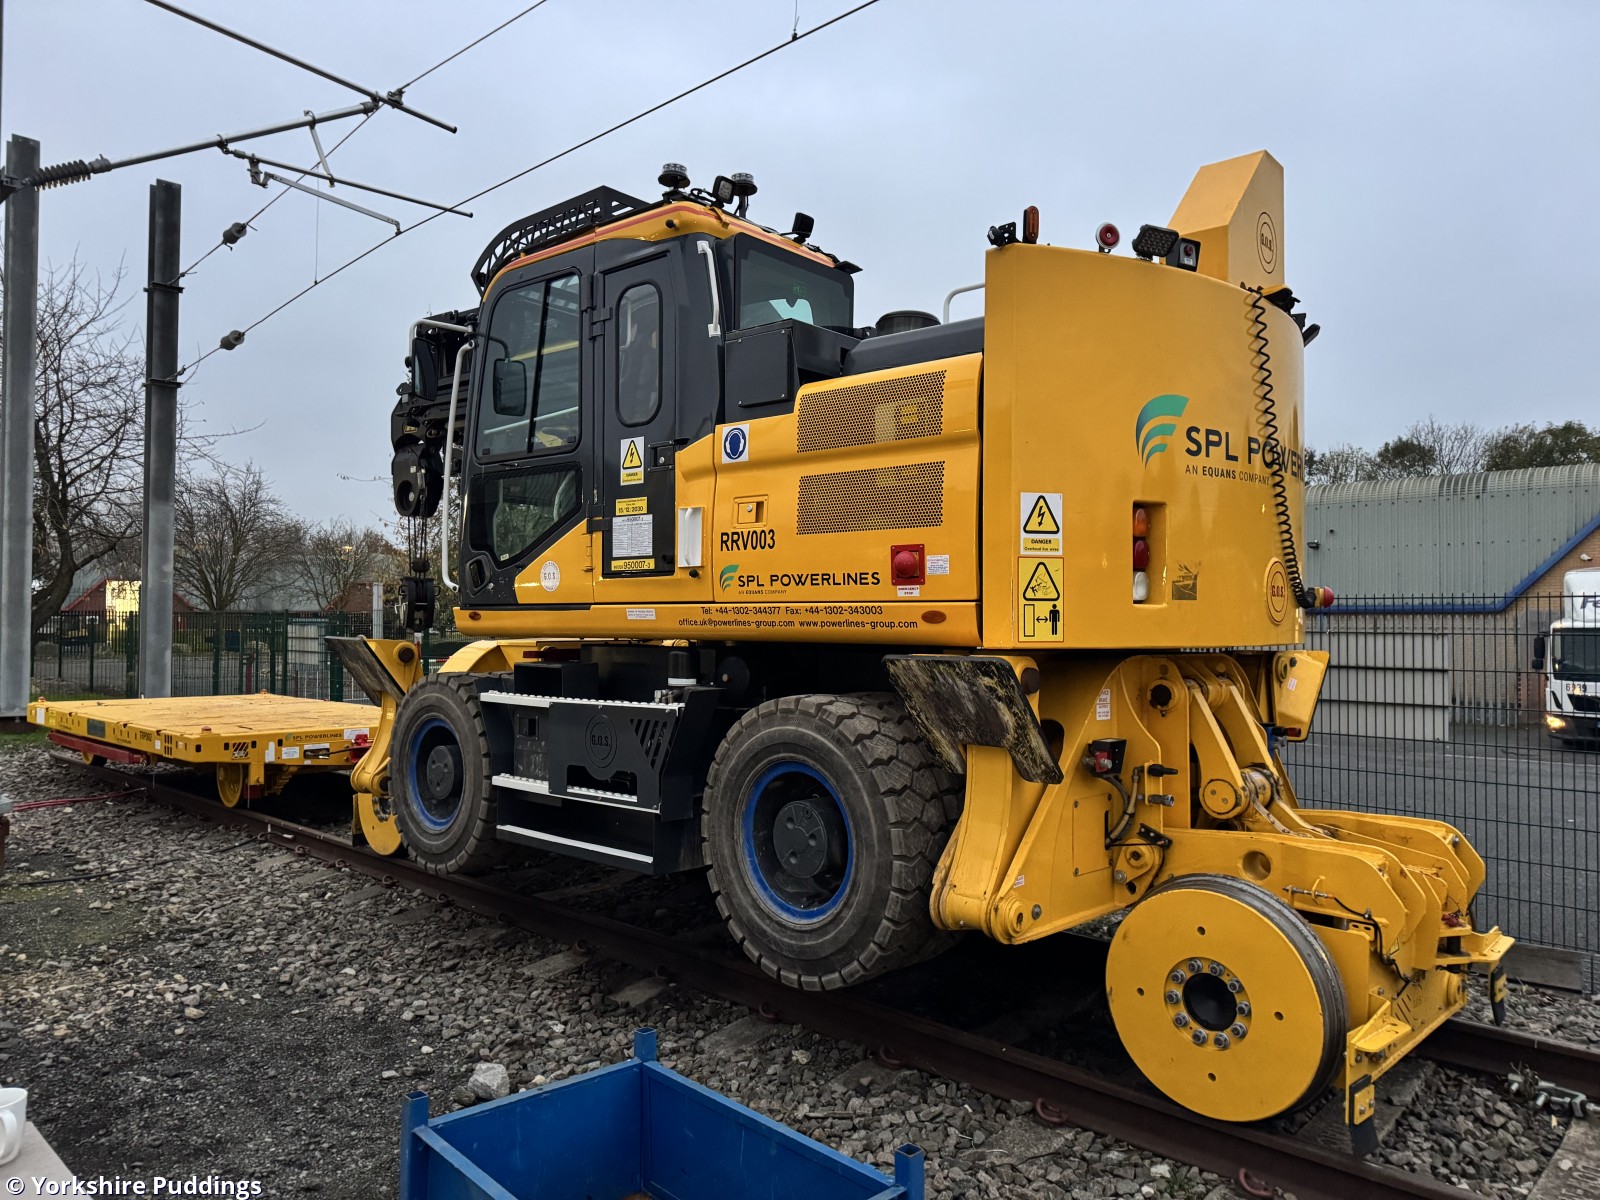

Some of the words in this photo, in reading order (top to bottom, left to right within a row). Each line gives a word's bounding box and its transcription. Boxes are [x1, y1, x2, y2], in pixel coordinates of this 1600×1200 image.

[1185, 425, 1239, 462] SPL
[1185, 464, 1198, 475] AN
[1202, 467, 1237, 480] EQUANS
[720, 529, 776, 552] RRV003
[738, 575, 765, 588] SPL
[770, 571, 881, 587] POWERLINES
[701, 606, 713, 615] Tel:
[715, 606, 781, 615] +44-1302-344377
[785, 606, 802, 615] Fax:
[804, 605, 883, 615] +44-1302-343003
[678, 618, 796, 629] office.uk@powerlines-group.com
[798, 618, 918, 630] www.powerlines-group.com
